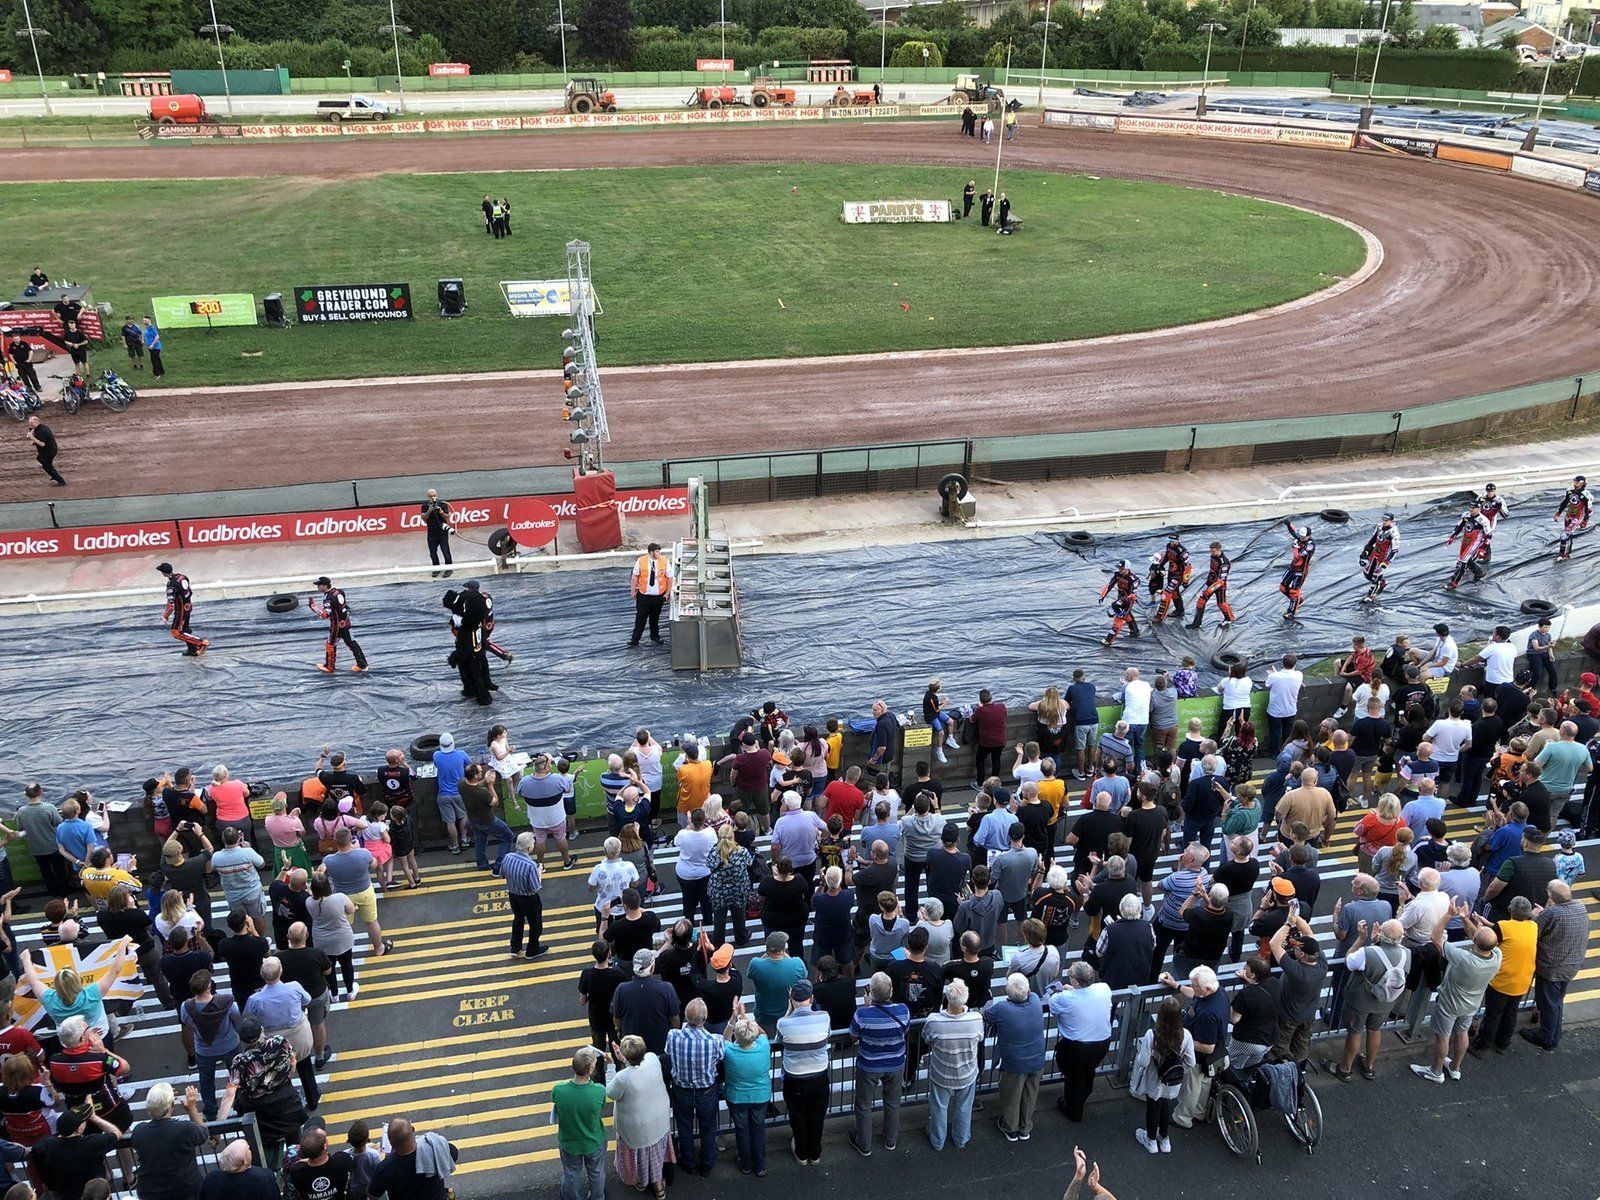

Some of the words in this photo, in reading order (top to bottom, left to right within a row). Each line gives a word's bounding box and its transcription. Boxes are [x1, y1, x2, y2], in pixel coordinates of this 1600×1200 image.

[853, 108, 872, 116] SKIPS
[242, 126, 265, 135] NGK
[295, 125, 318, 134] NGK
[346, 125, 368, 133] NGK
[372, 124, 394, 132] NGK
[397, 123, 419, 131] NGK
[448, 120, 469, 128] NGK
[472, 119, 493, 127] NGK
[496, 118, 518, 126] NGK
[521, 117, 542, 125] NGK
[545, 116, 566, 124] NGK
[569, 115, 591, 123] NGK
[640, 113, 661, 122] NGK
[663, 112, 684, 120] NGK
[687, 112, 707, 120] NGK
[732, 109, 752, 118] NGK
[755, 108, 774, 117] NGK
[777, 108, 797, 116] NGK
[800, 108, 820, 116] NGK
[1306, 132, 1349, 140] INTERNATIONAL
[1382, 137, 1408, 146] COVERING
[1416, 141, 1436, 149] WORLD
[869, 203, 924, 216] PARRYS
[317, 288, 387, 301] GREYHOUND
[198, 302, 220, 313] 200
[318, 299, 389, 312] TRADER.COM
[349, 310, 408, 320] GREYHOUNDS
[616, 494, 686, 513] adbrokes
[401, 506, 490, 528] Laokes
[295, 515, 387, 536] Ladbrokes
[511, 519, 556, 530] Ladbrokes
[188, 522, 282, 543] Ladbrokes
[74, 529, 171, 551] Ladbrokes
[478, 890, 510, 902] KEE
[472, 900, 512, 914] CLEA
[460, 996, 510, 1011] KEEP
[452, 1009, 516, 1027] CLEAR
[308, 1187, 338, 1199] YAMAHA
